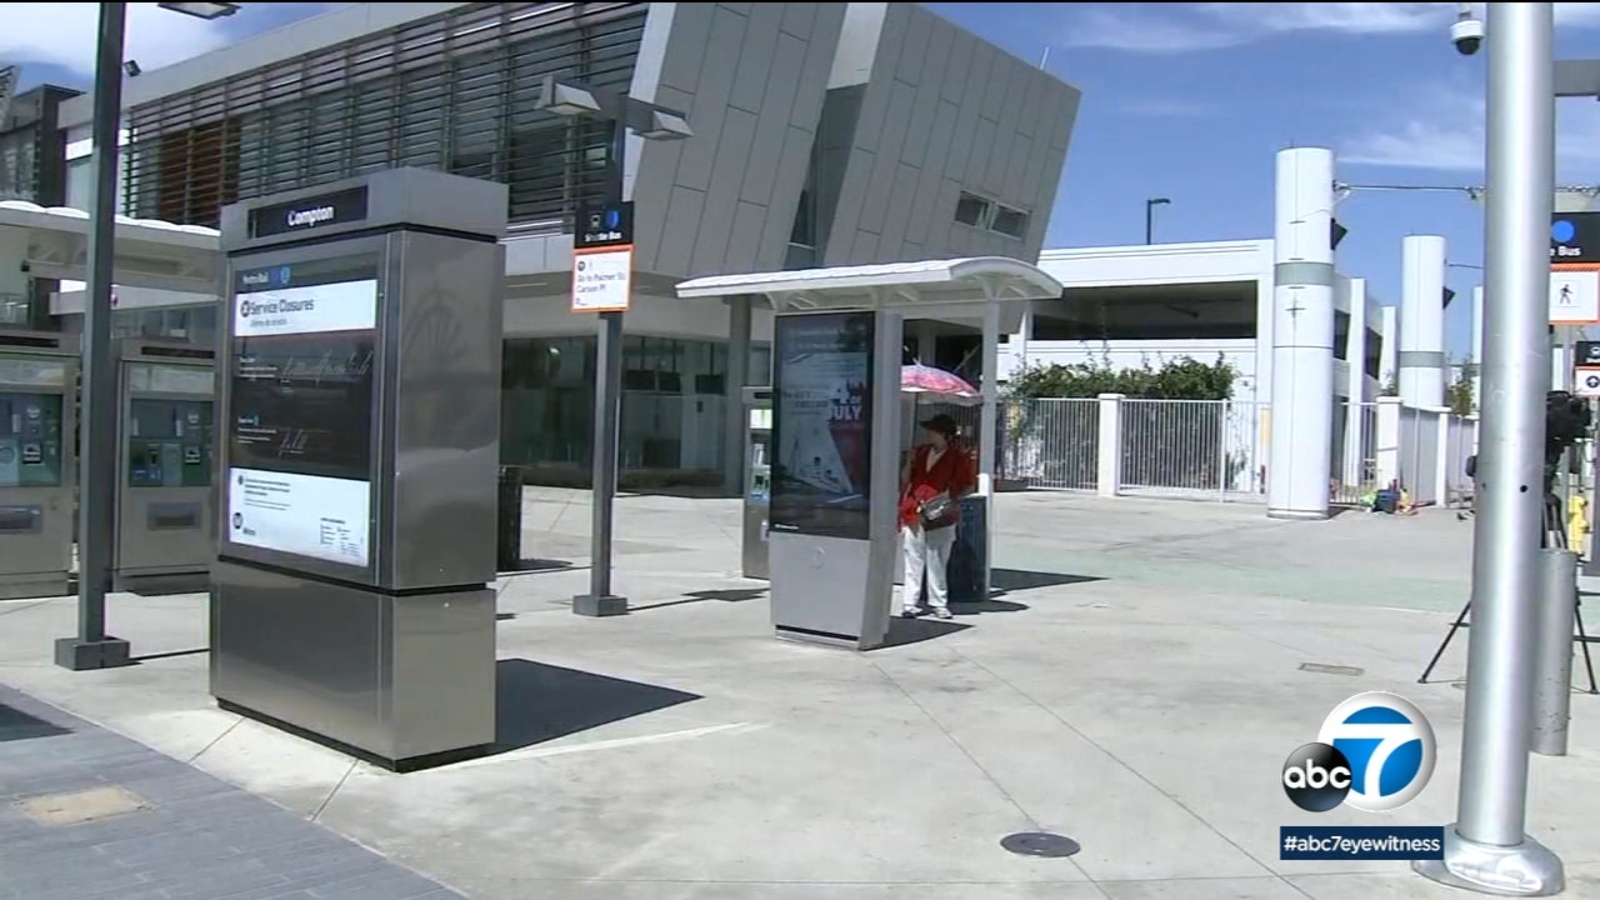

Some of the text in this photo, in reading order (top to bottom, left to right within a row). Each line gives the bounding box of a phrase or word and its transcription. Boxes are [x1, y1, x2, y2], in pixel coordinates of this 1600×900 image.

[287, 205, 335, 228] Compton
[1558, 245, 1581, 256] Bus
[250, 298, 314, 315] Service Closures
[829, 403, 861, 421] JULY
